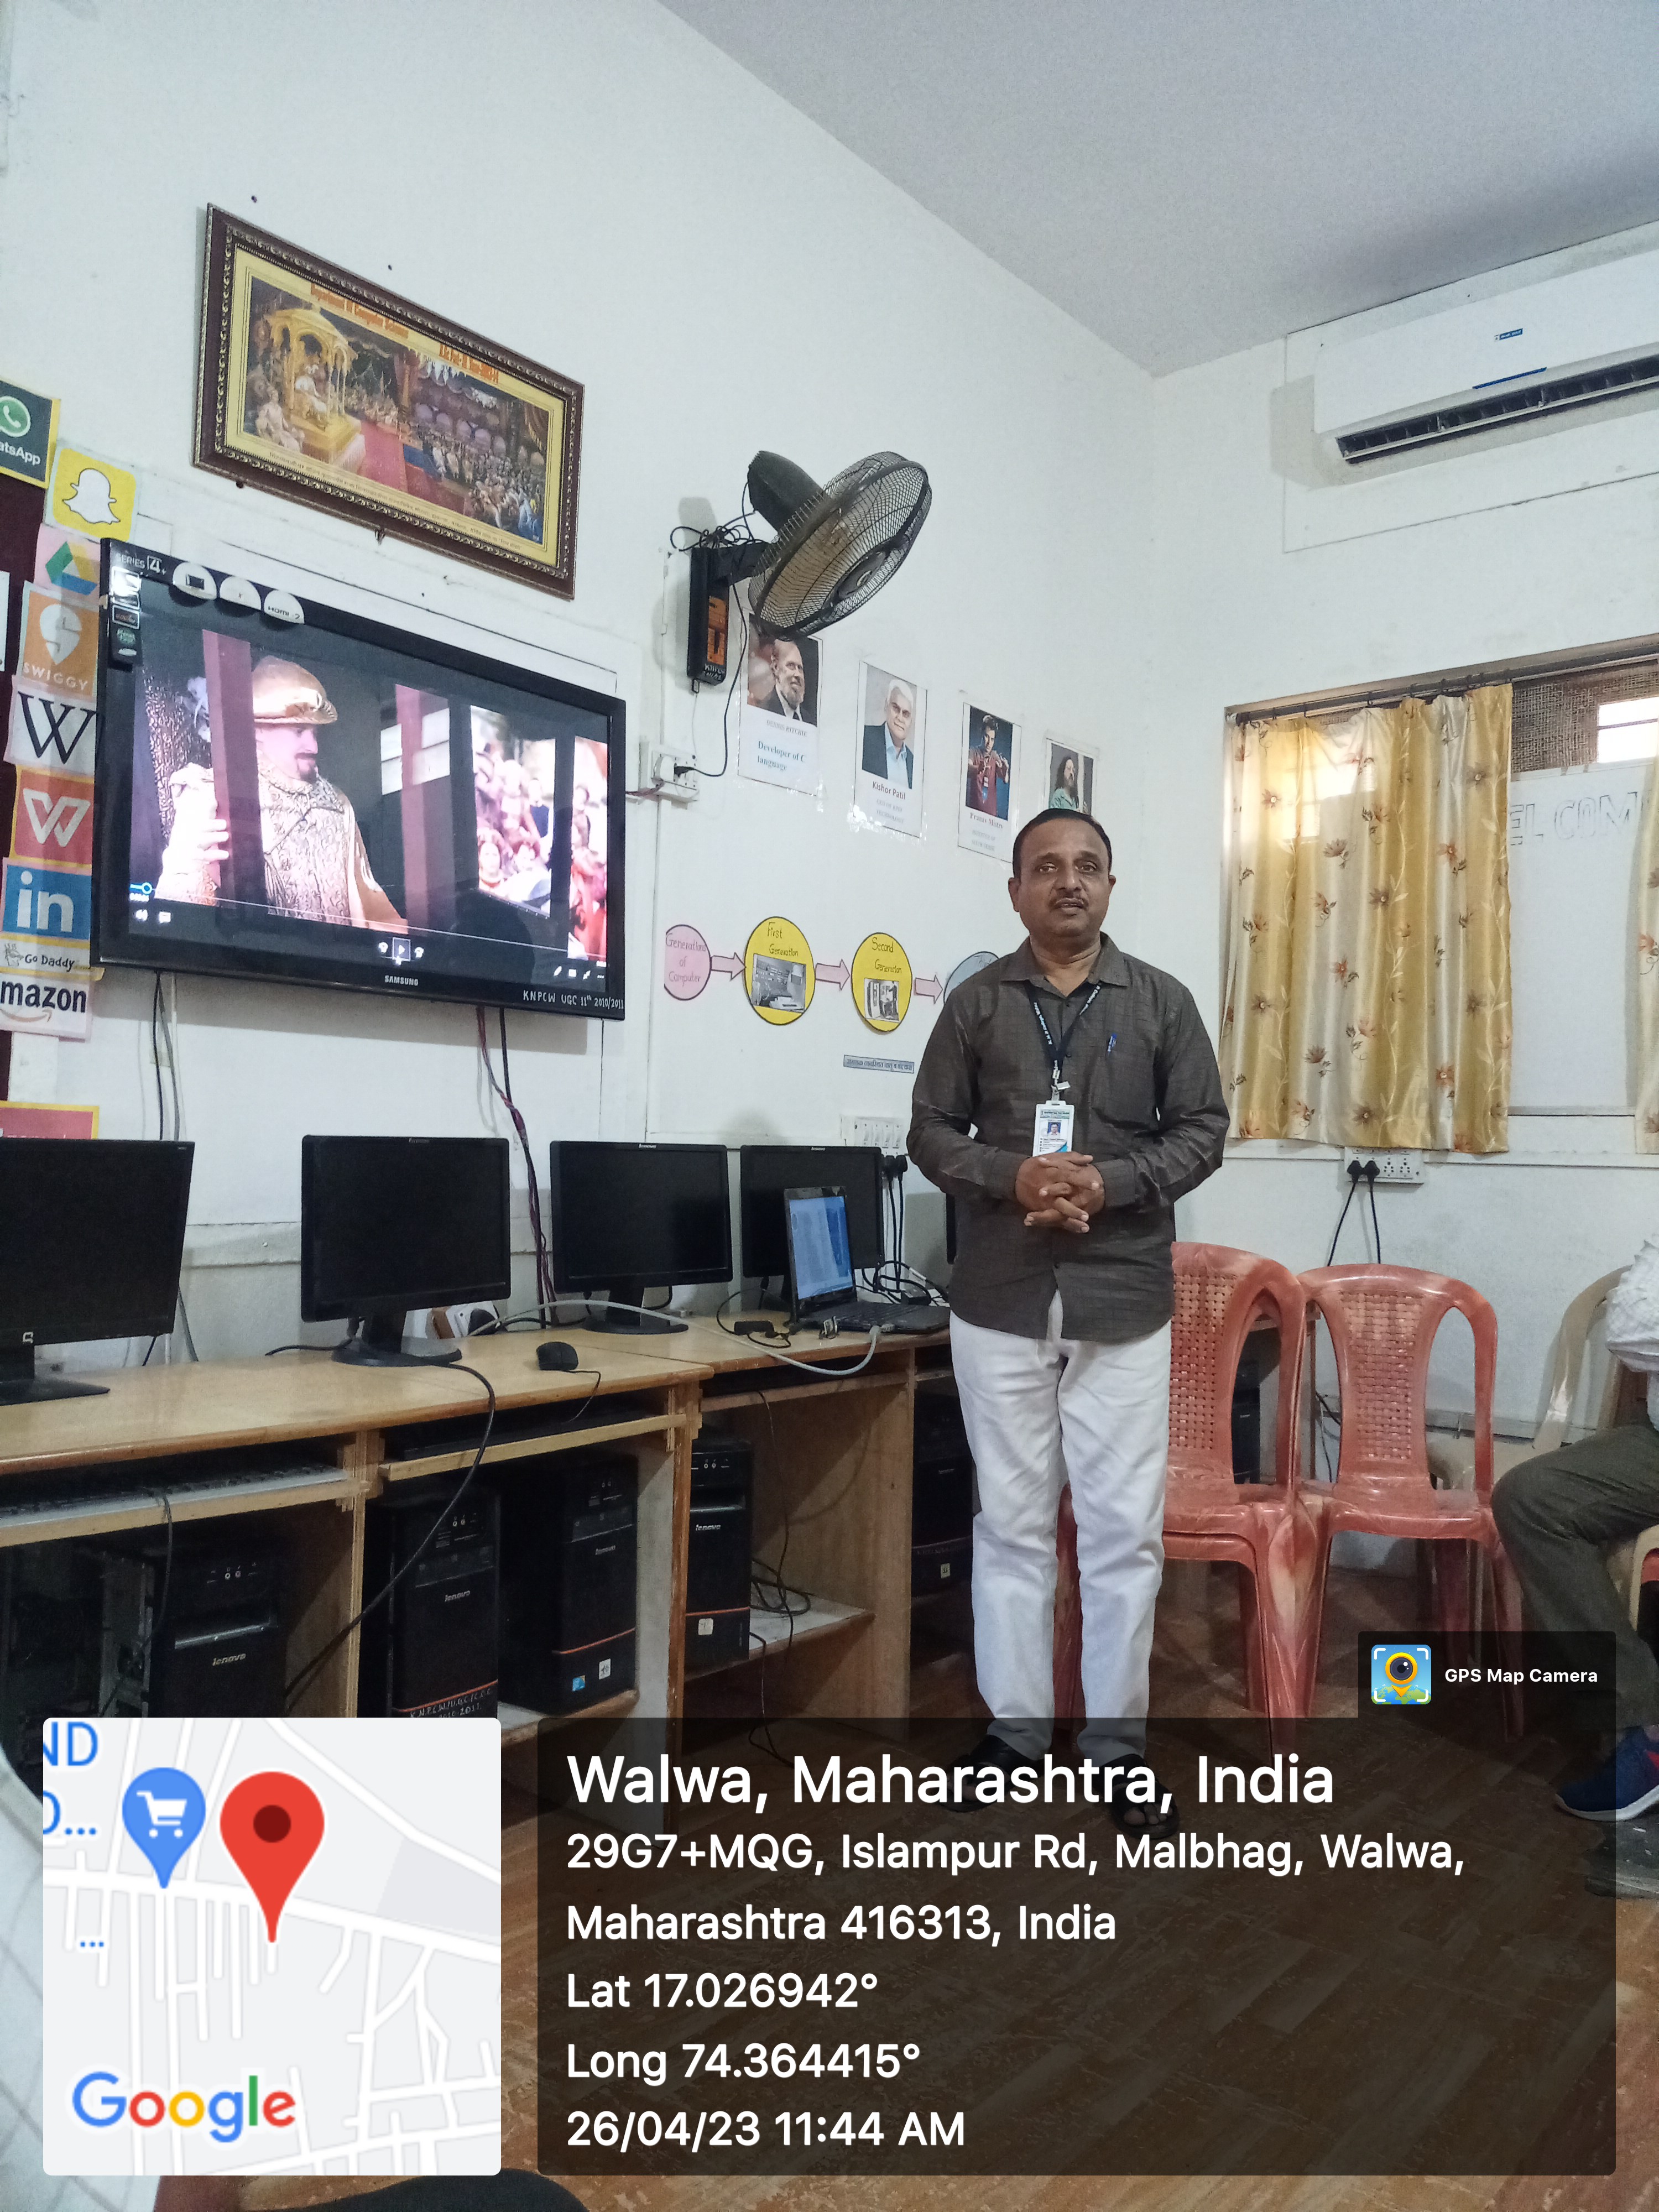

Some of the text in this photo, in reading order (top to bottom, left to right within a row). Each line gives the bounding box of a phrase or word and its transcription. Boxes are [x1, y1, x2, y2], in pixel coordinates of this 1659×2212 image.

[0, 441, 41, 466] atsApp
[23, 662, 88, 691] SWIGGY
[758, 740, 806, 763] Developer of C
[757, 755, 787, 771] language
[873, 781, 905, 800] Kishor Patil
[1510, 791, 1639, 846] ELCOM
[17, 870, 74, 932] in
[767, 922, 782, 939] First
[769, 943, 799, 957] Generation
[872, 937, 894, 953] Second
[25, 954, 75, 972] Go Daddy
[679, 956, 687, 967] of
[874, 958, 902, 974] Generation
[384, 975, 419, 987] SAMSUNG
[668, 971, 701, 987] Computer
[0, 980, 87, 1013] mazon
[523, 990, 556, 1003] KNPCW
[561, 994, 577, 1005] UGC
[594, 997, 624, 1010] 2010/2011
[212, 1653, 246, 1666] lenovo
